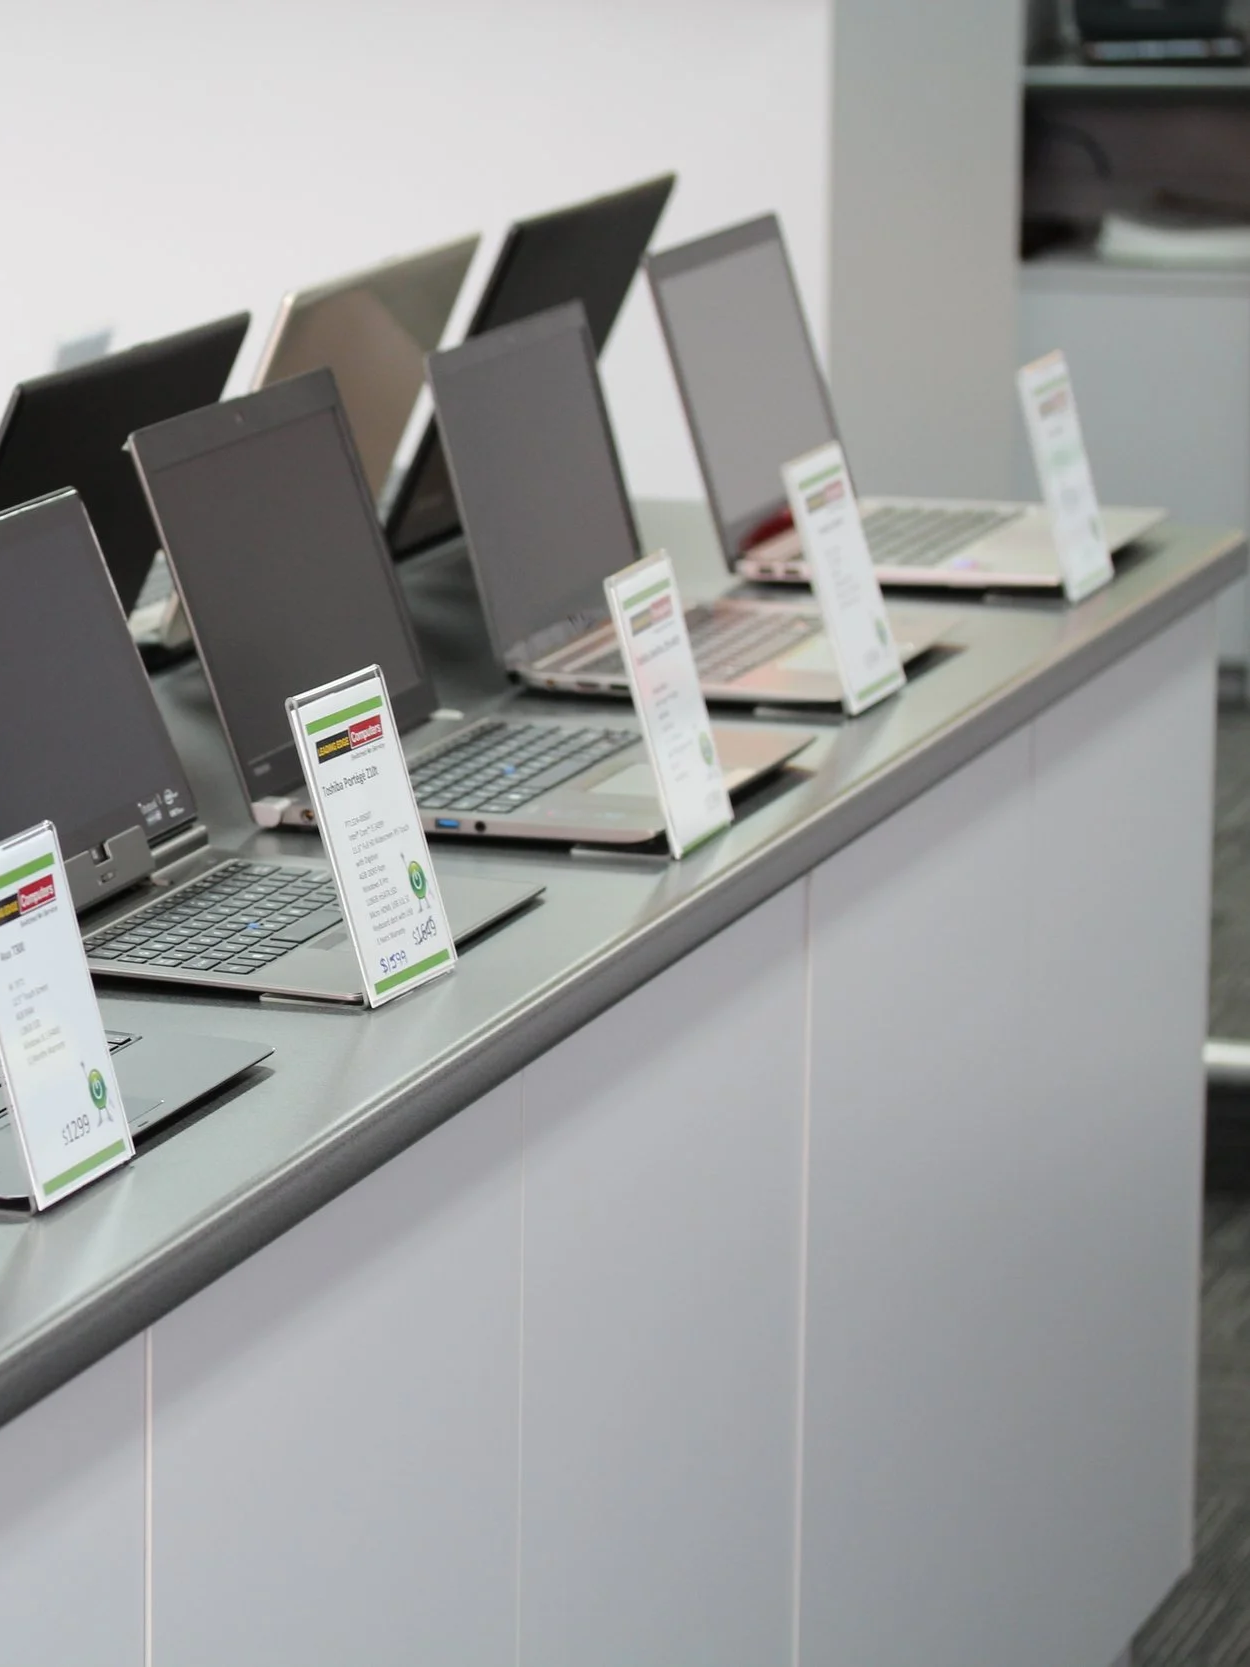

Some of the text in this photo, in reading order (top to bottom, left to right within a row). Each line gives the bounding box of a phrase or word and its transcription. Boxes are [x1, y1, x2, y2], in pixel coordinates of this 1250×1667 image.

[318, 724, 381, 757] LEADING EDGE Computers
[322, 780, 343, 796] Toshiba
[21, 885, 54, 908] Computers
[62, 1114, 90, 1146] $1299
